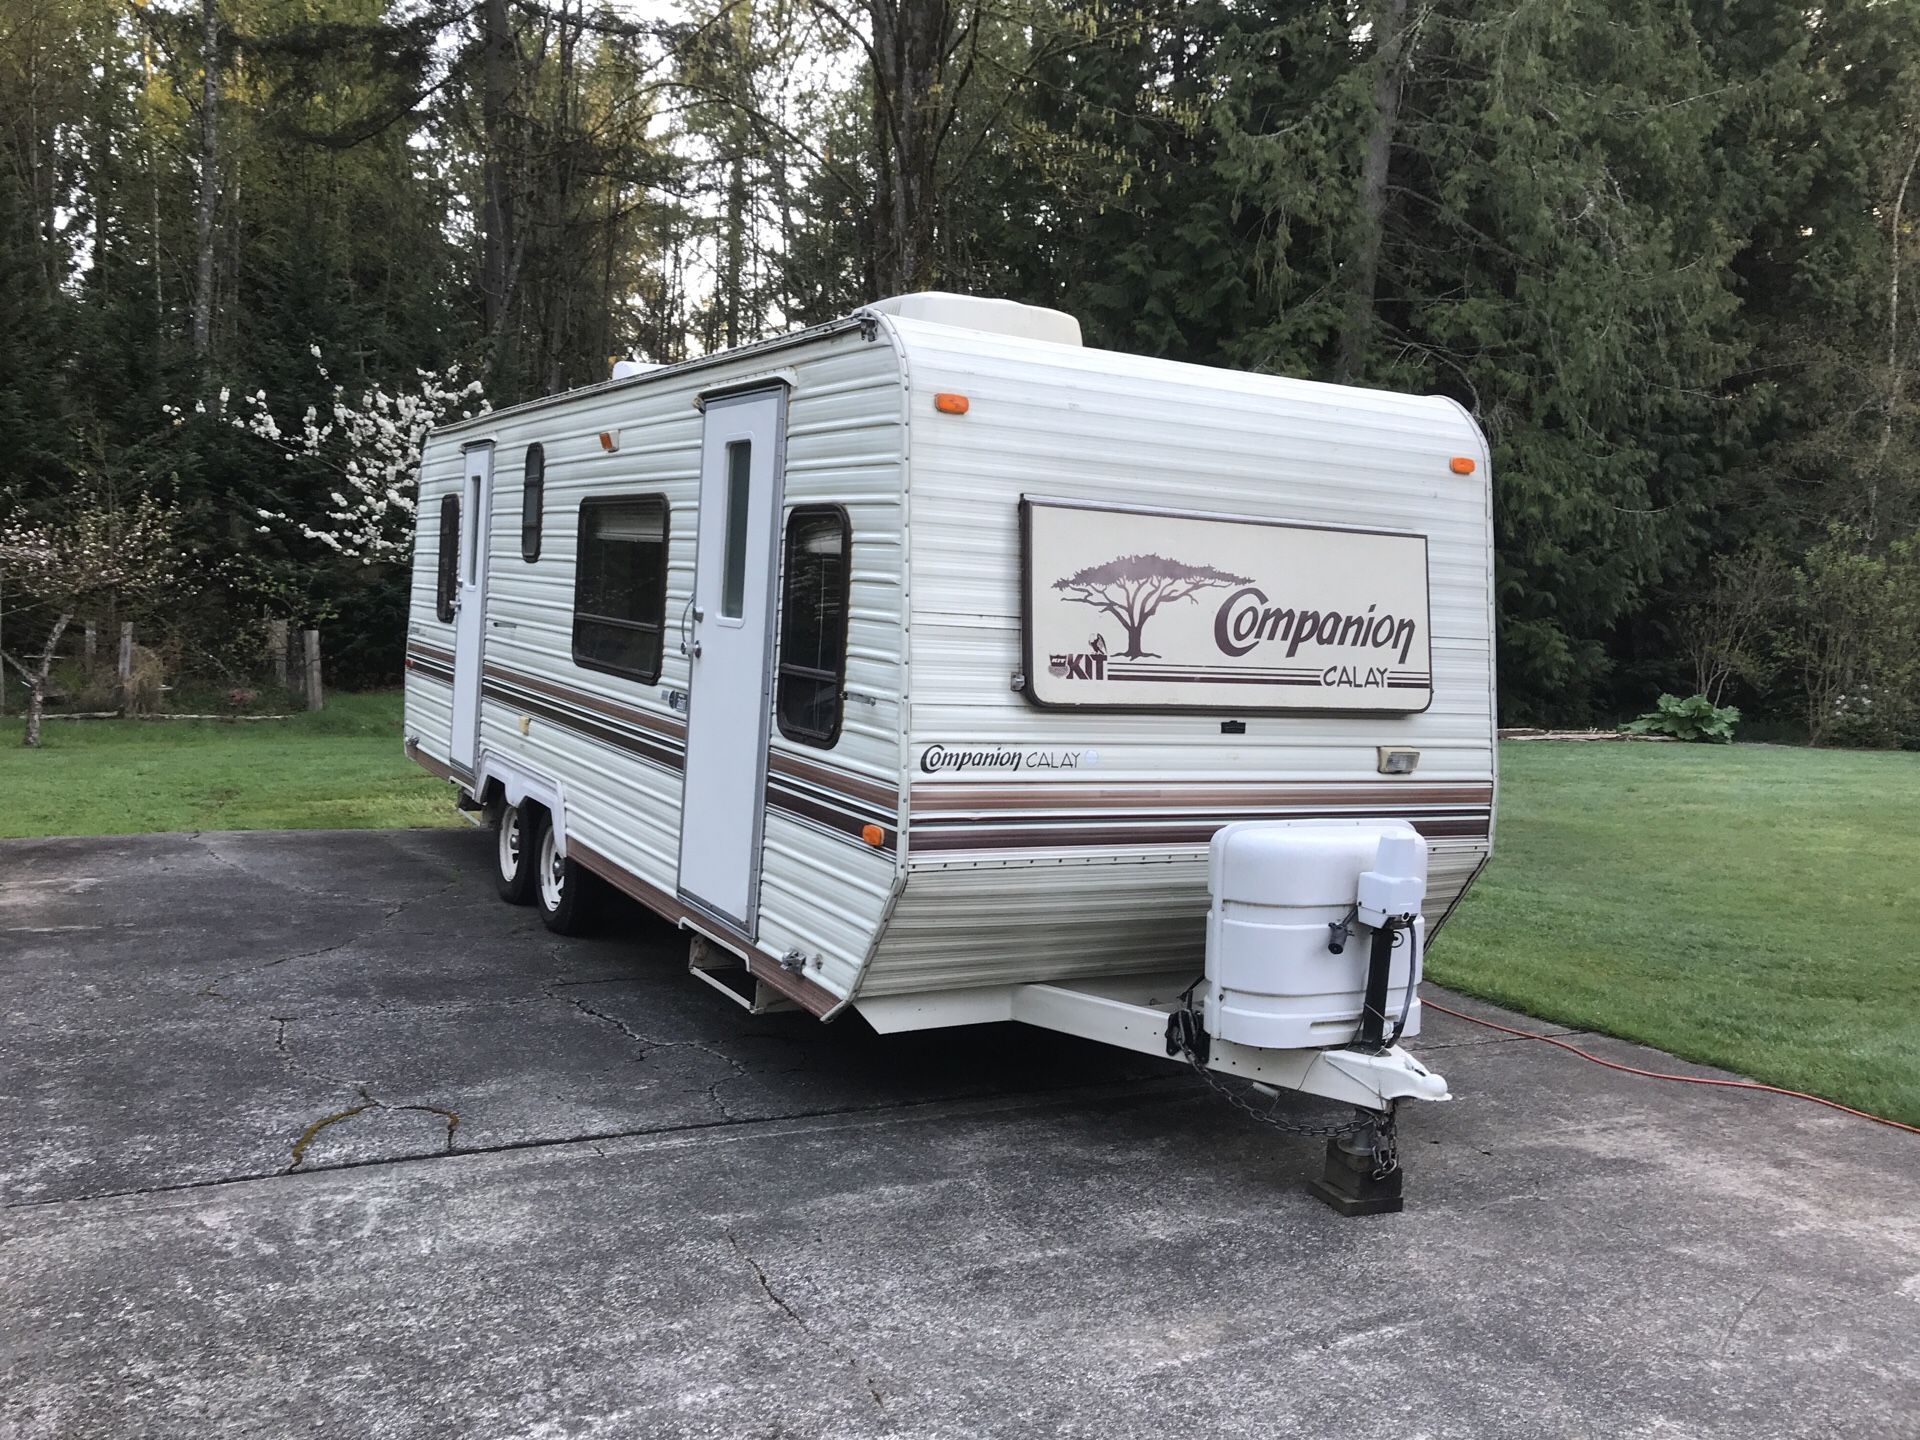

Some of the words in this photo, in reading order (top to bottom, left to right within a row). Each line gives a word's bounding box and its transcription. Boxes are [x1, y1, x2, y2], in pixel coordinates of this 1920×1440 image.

[1214, 587, 1416, 664] Companion
[1066, 654, 1108, 680] KIT
[1323, 666, 1388, 688] CALAY
[920, 744, 1022, 774] Companion
[1026, 752, 1080, 768] CALAY
